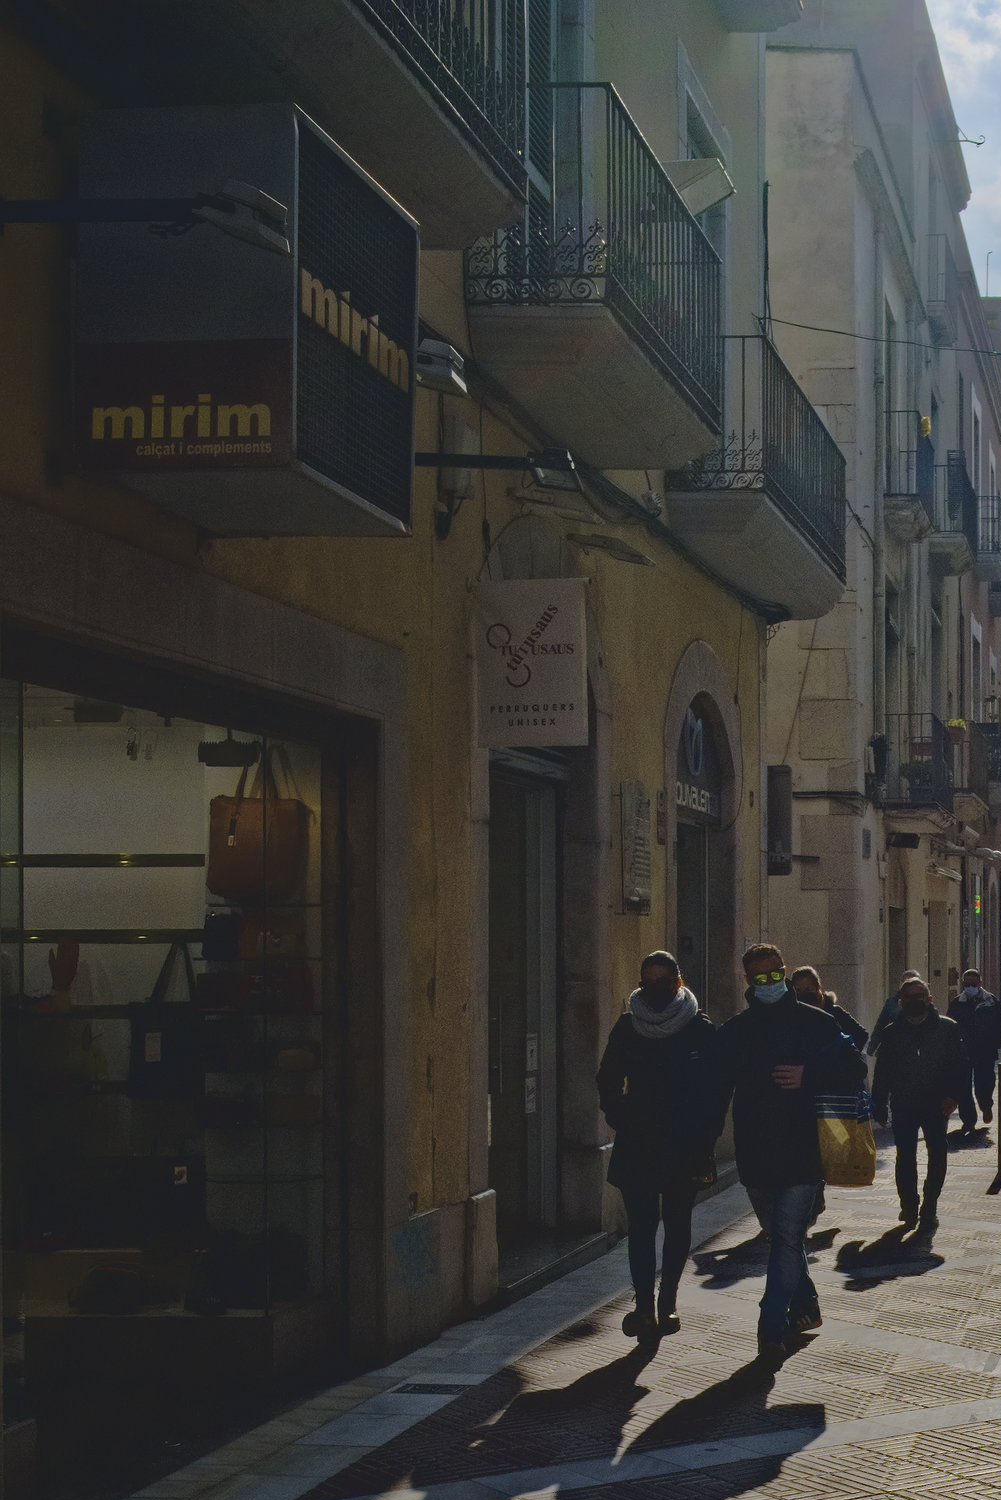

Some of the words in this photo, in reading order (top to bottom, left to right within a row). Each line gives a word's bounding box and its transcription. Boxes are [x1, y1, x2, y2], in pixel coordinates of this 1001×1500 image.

[301, 267, 410, 393] mirim
[91, 394, 271, 440] mirim
[136, 441, 177, 458] calçat
[179, 441, 184, 455] i
[186, 441, 272, 458] complements
[490, 703, 575, 713] PERRUQUERS
[508, 718, 556, 727] UNISEX
